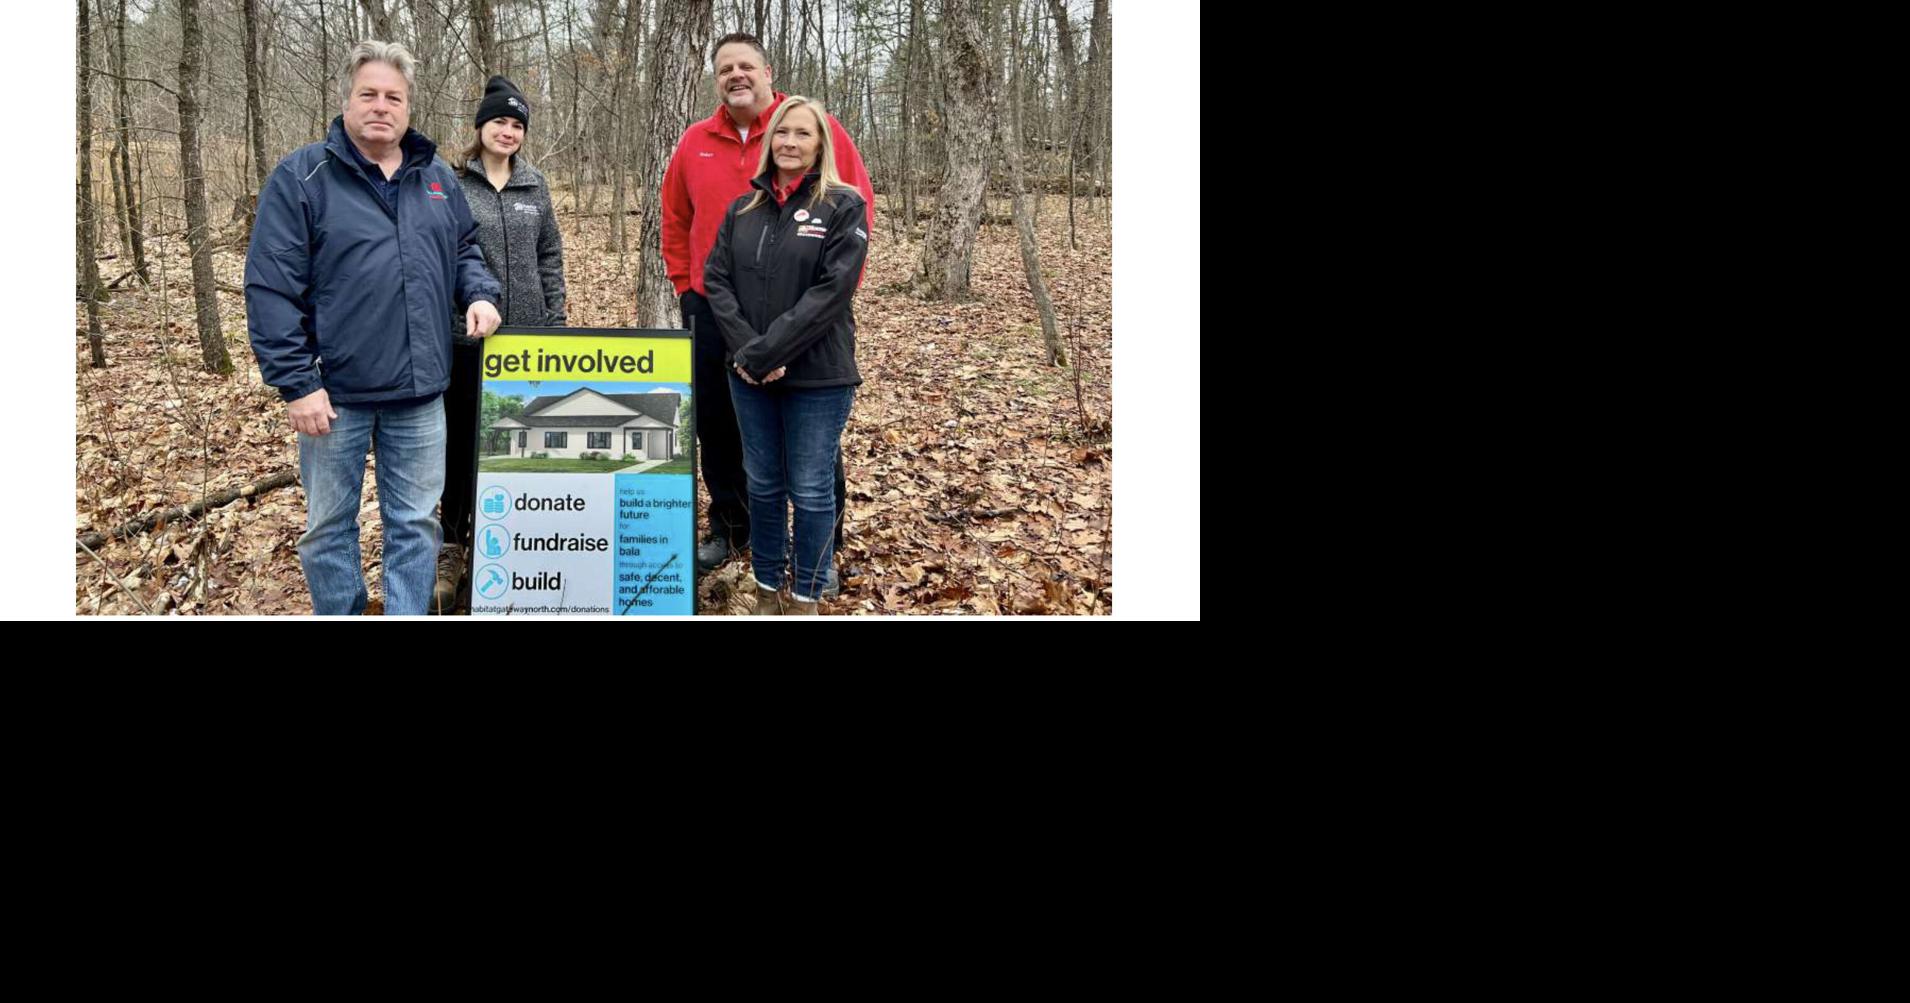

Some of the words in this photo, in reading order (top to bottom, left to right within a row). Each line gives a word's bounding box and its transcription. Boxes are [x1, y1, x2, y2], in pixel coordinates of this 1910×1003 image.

[485, 350, 530, 378] get
[537, 348, 654, 374] involved
[514, 493, 586, 511] donate
[620, 499, 644, 507] build
[653, 499, 692, 509] brighter
[620, 510, 649, 519] future
[513, 533, 609, 551] fundraise
[620, 534, 658, 544] families
[660, 535, 669, 544] in
[619, 547, 640, 556] bala
[512, 572, 561, 590] build
[619, 572, 643, 583] safe,
[619, 585, 638, 594] and
[619, 597, 653, 607] homes
[471, 604, 609, 614] abitatgatwaynorth.com/donations
